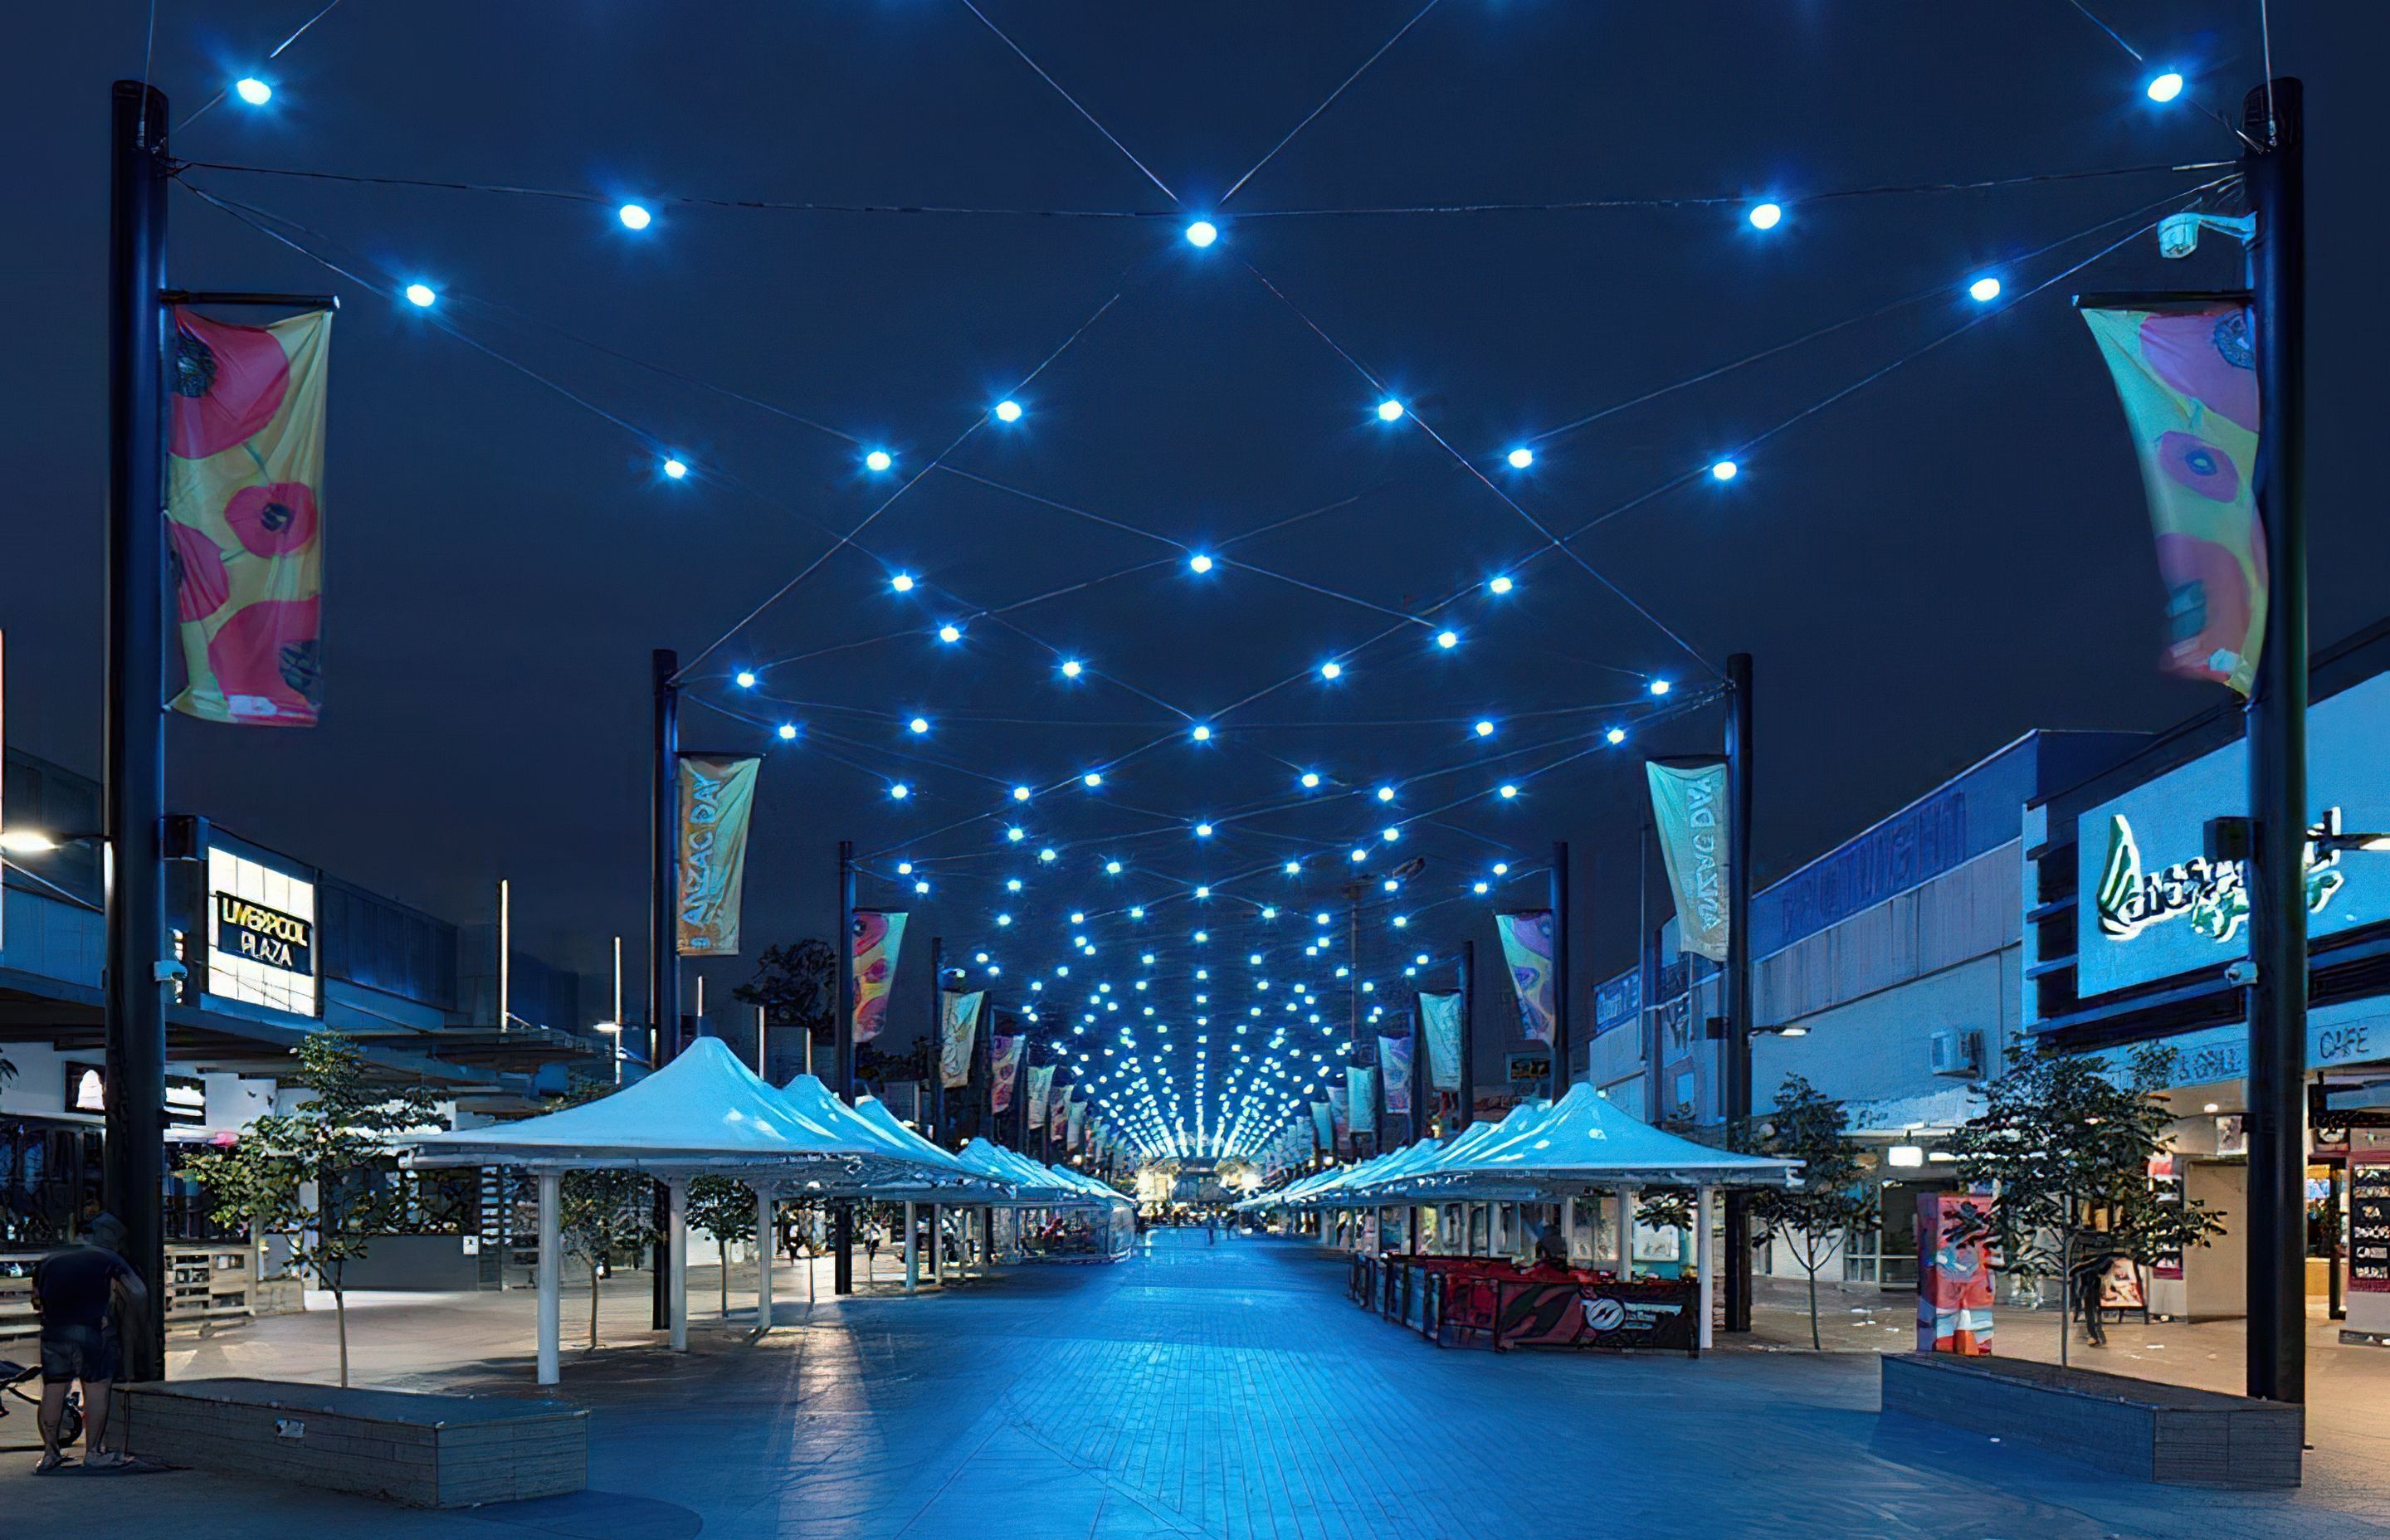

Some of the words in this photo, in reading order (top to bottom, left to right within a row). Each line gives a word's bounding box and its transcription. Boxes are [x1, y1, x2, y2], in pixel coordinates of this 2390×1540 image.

[690, 772, 722, 824] DAY
[1687, 775, 1716, 827] DAY
[241, 929, 293, 967] PLAZA
